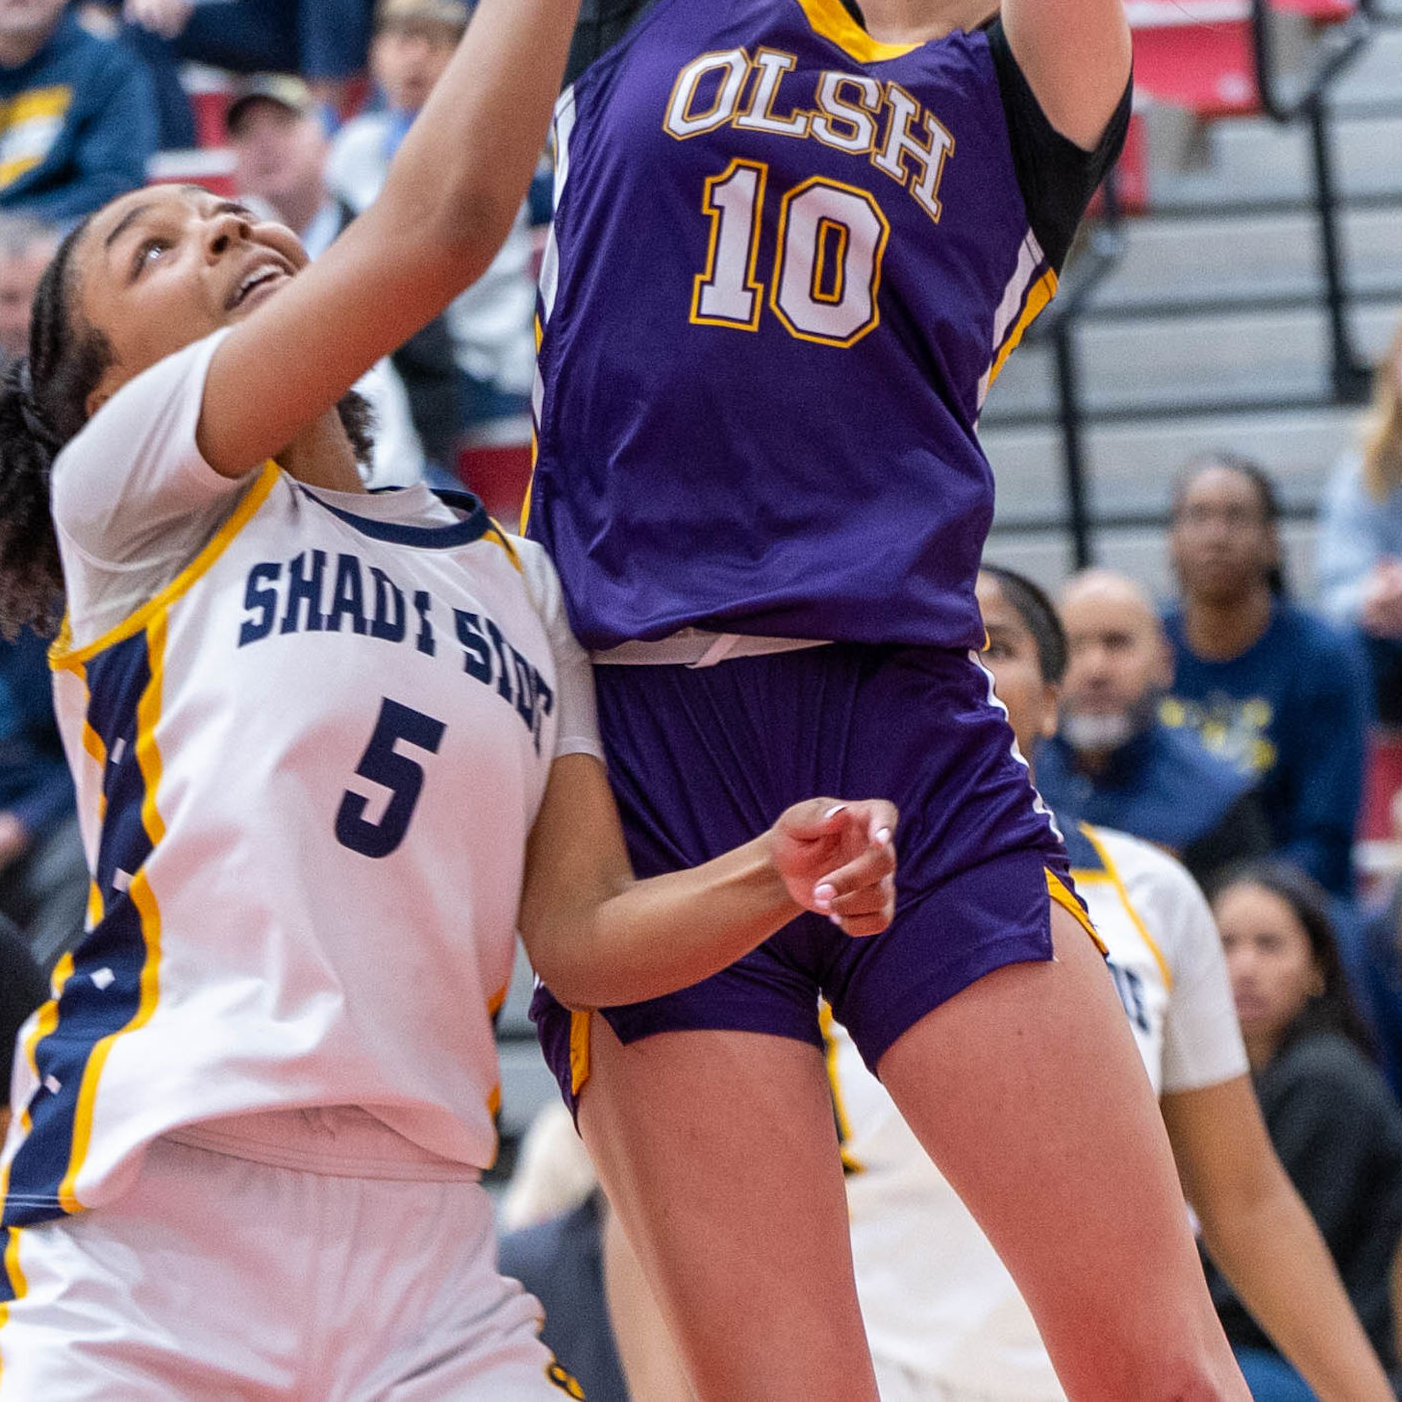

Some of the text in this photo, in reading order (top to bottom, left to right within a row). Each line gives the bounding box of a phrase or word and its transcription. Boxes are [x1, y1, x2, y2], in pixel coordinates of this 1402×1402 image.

[663, 46, 955, 223] OLSH
[689, 157, 890, 348] 10
[335, 697, 447, 859] 5
